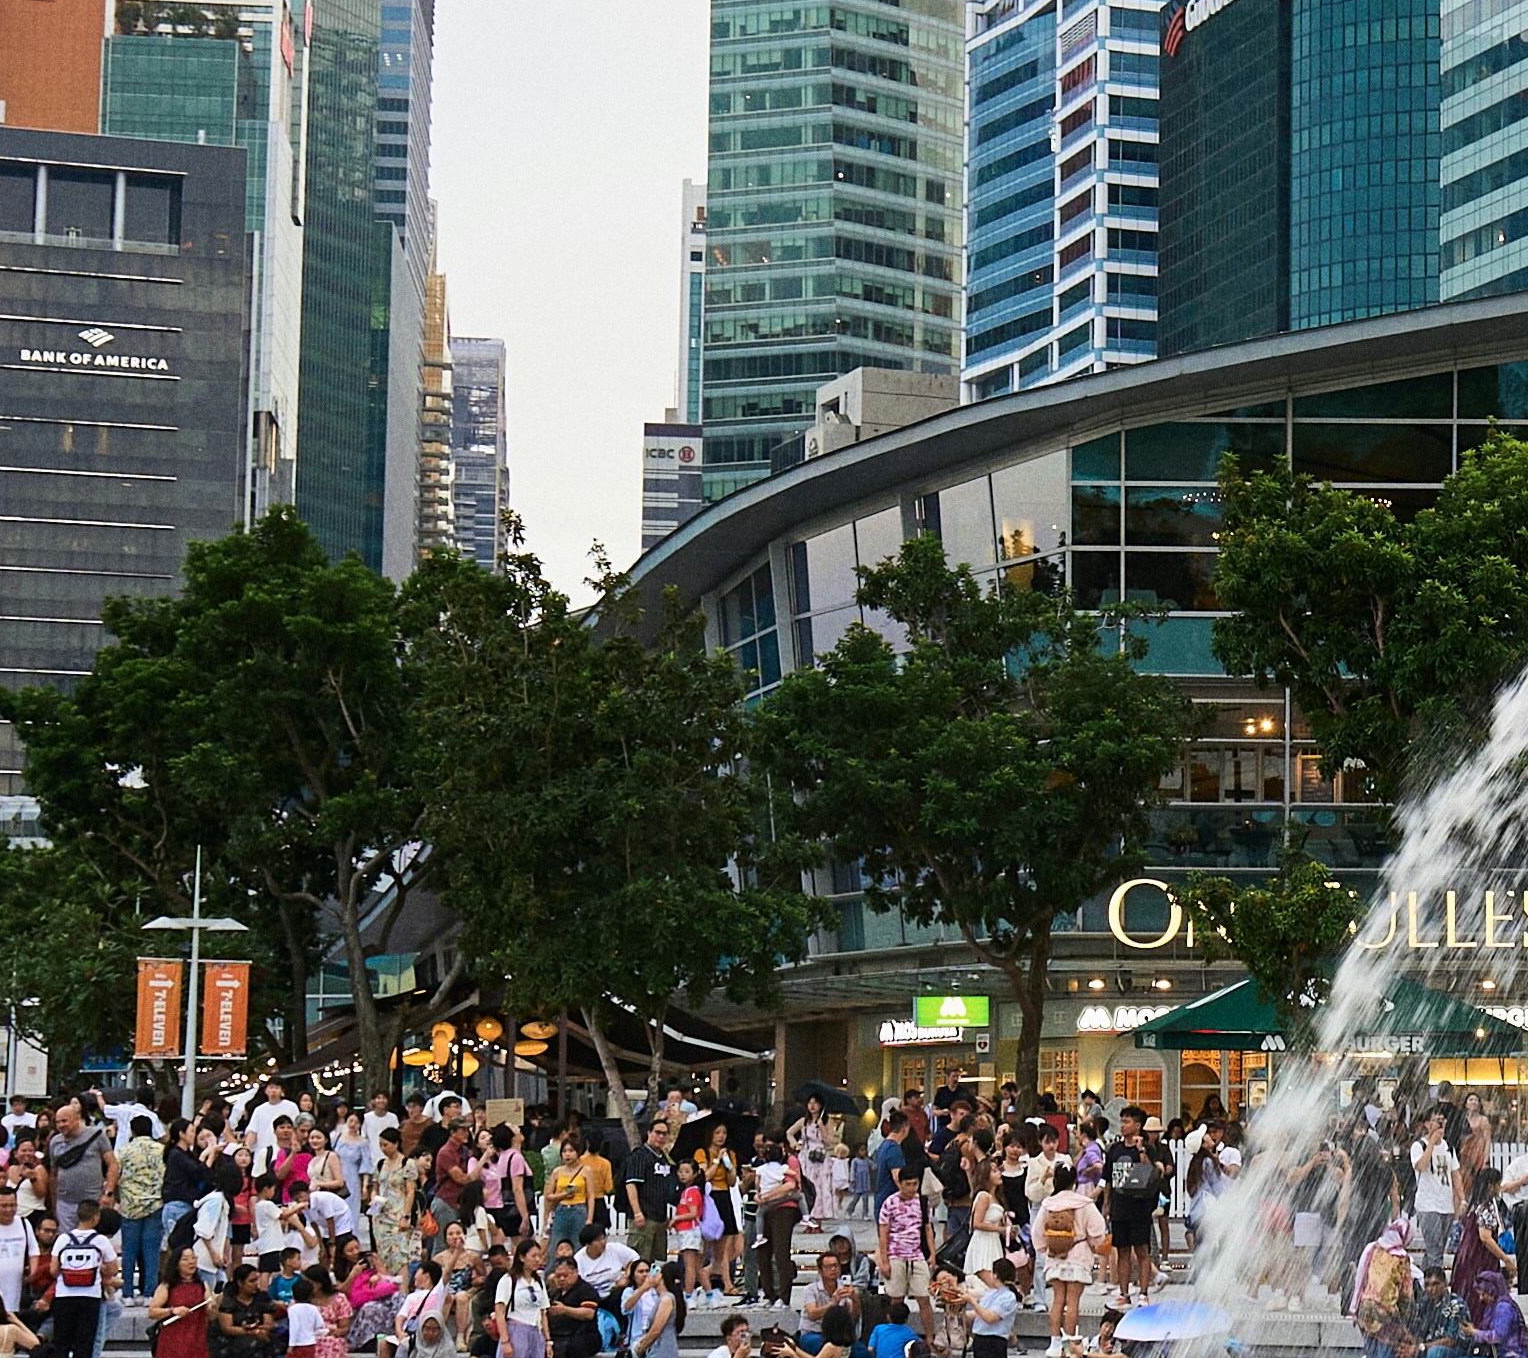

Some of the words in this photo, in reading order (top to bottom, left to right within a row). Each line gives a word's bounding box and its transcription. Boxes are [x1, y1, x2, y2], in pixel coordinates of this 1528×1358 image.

[20, 349, 67, 364] BANK
[69, 352, 92, 365] OF
[93, 354, 169, 371] AMERICA
